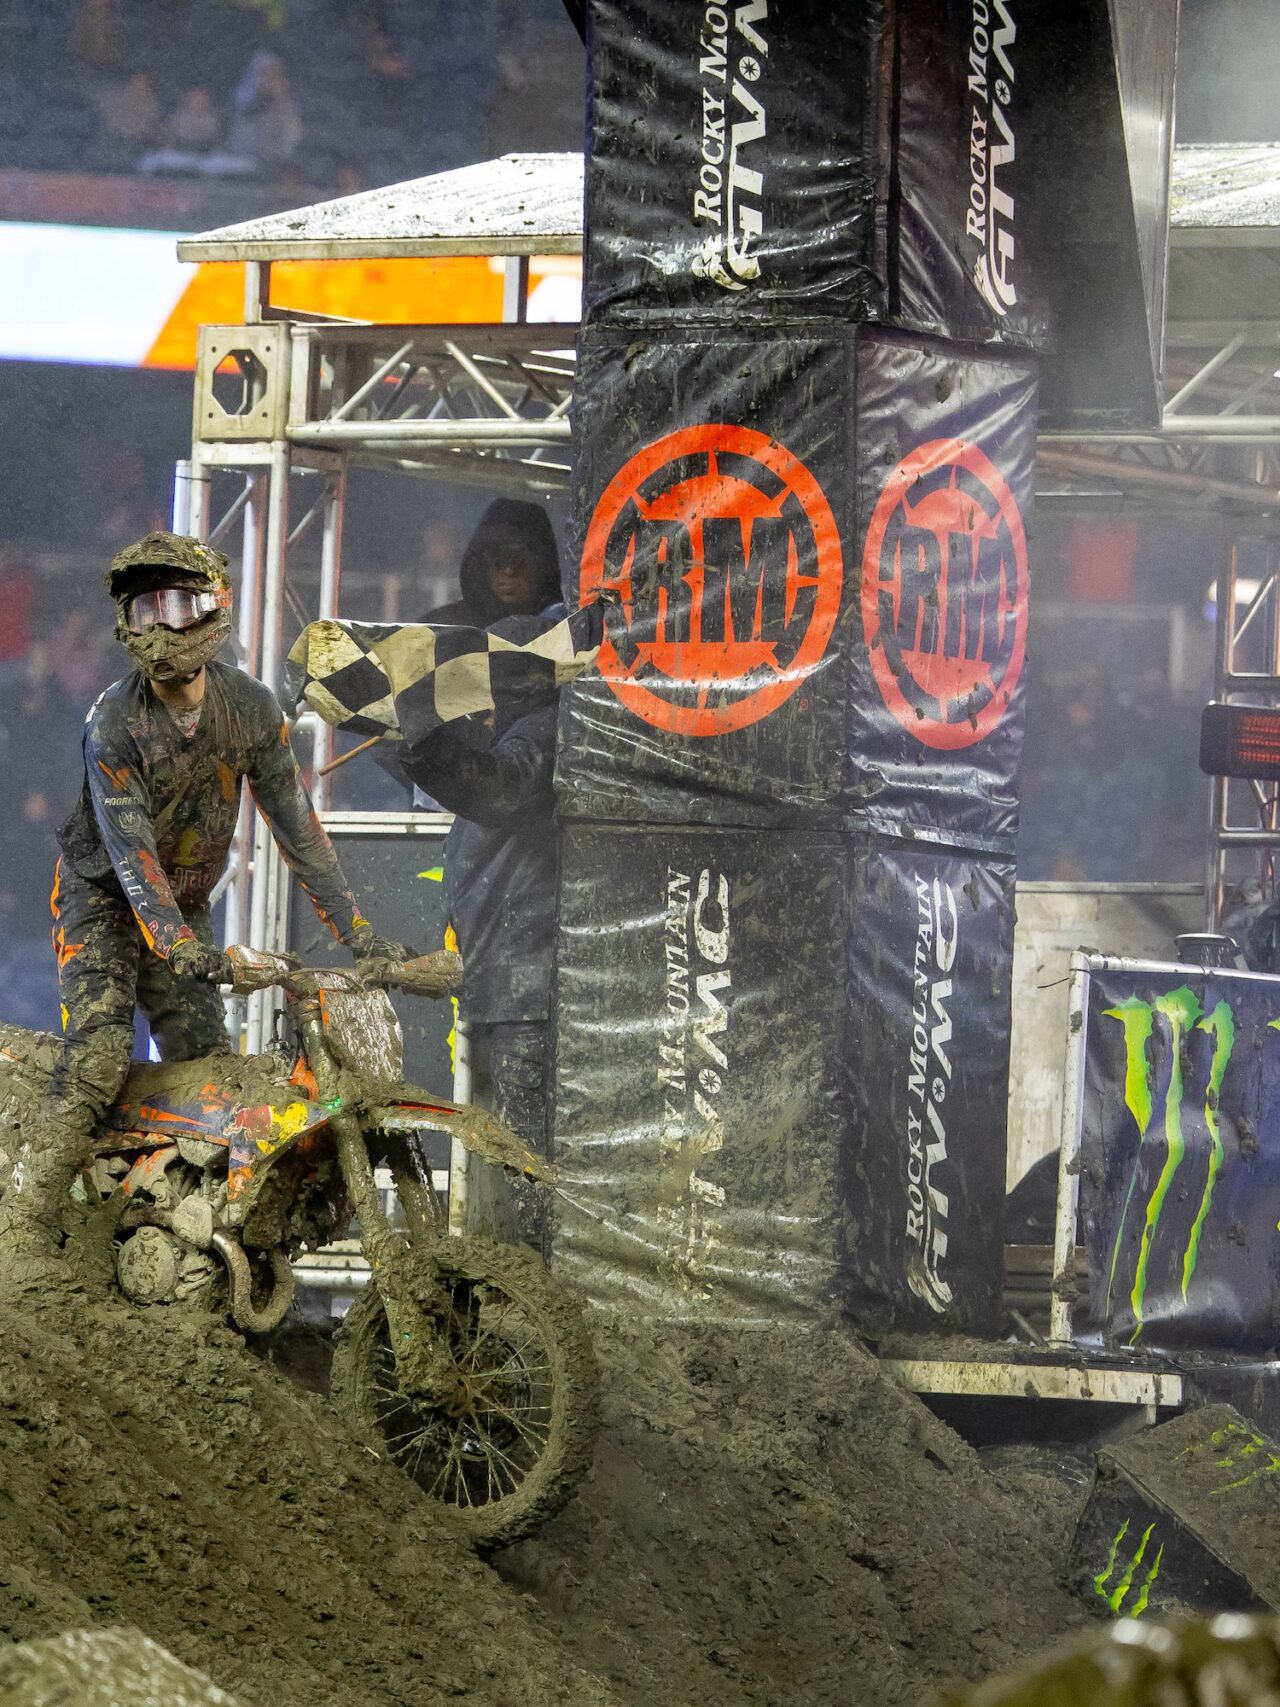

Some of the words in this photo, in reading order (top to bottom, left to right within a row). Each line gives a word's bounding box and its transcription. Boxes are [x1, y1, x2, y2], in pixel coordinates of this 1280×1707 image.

[699, 0, 728, 84] MO
[967, 0, 990, 104] MOU
[694, 87, 728, 227] ROCKY
[966, 105, 990, 246] ROCKY
[907, 872, 935, 1103] MOUNTAIN
[906, 1105, 925, 1239] ROCKY
